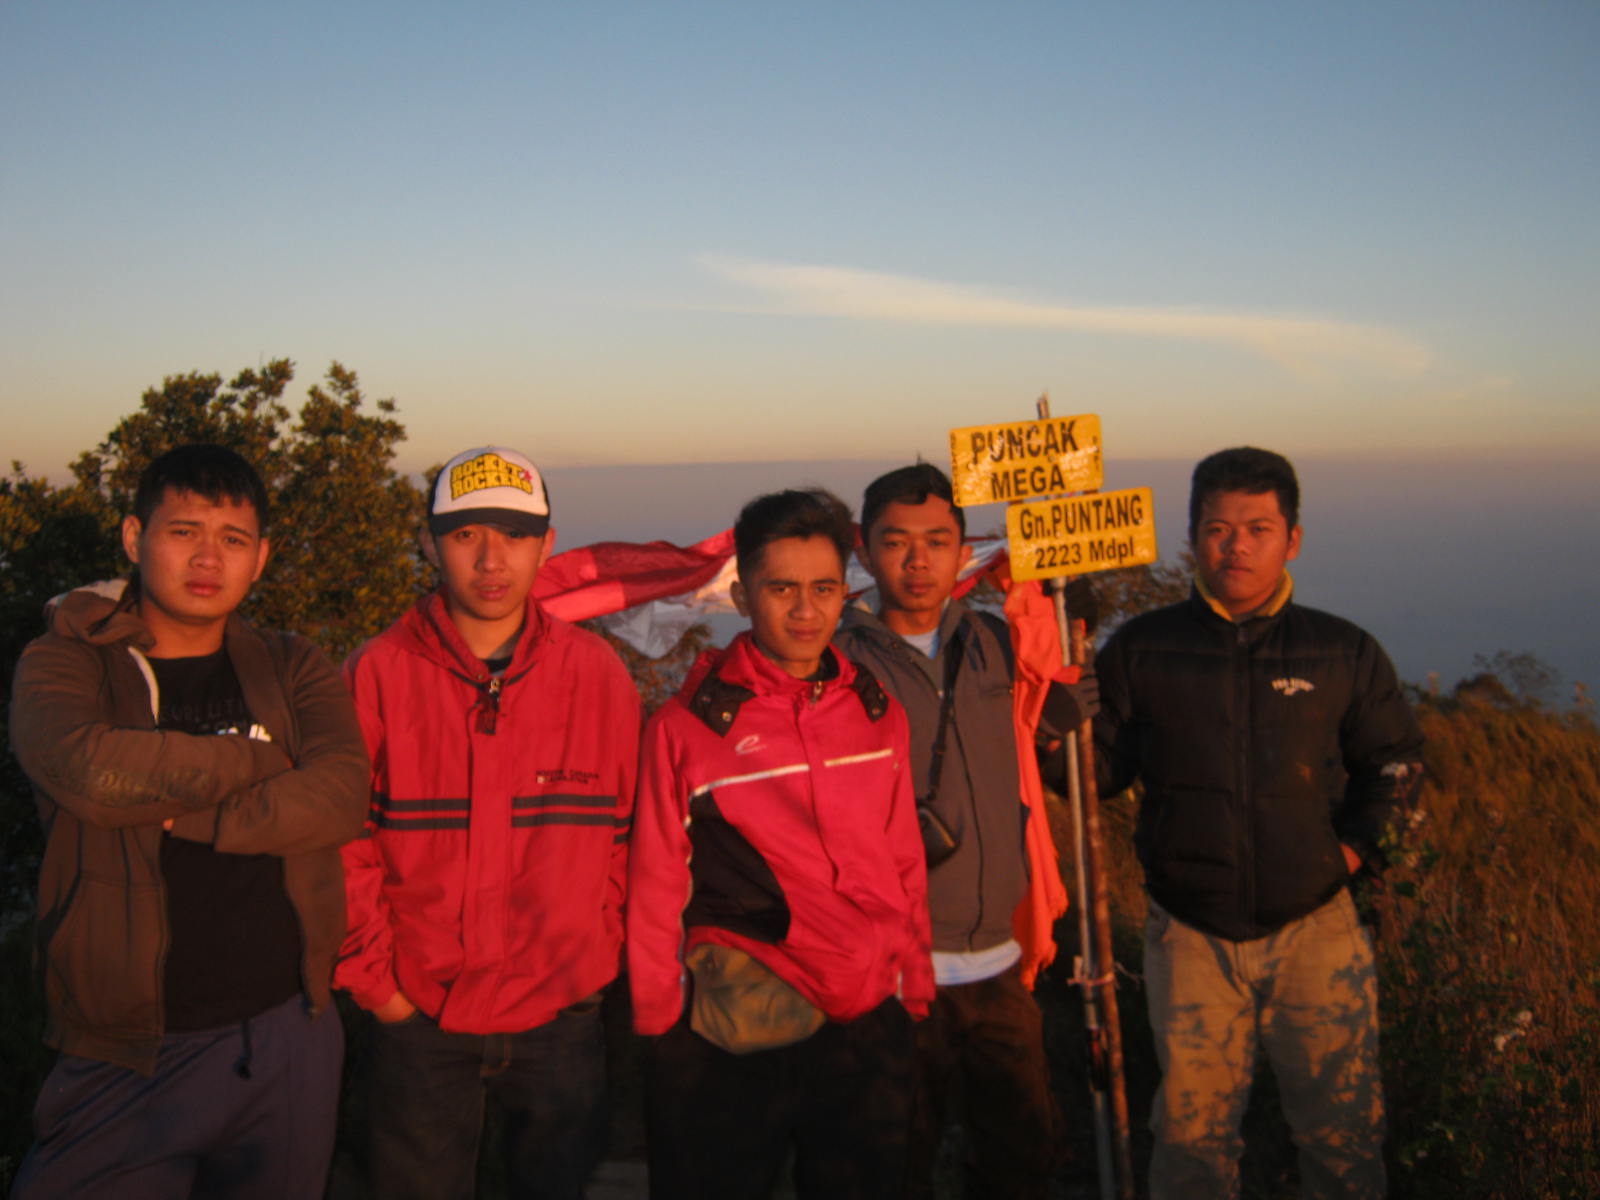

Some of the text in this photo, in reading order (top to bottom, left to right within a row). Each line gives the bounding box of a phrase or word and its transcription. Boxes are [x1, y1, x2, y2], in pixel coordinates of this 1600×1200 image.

[971, 420, 1078, 465] PUNCAK
[991, 464, 1066, 500] MEGA
[1035, 537, 1135, 570] 2223 Mdpl
